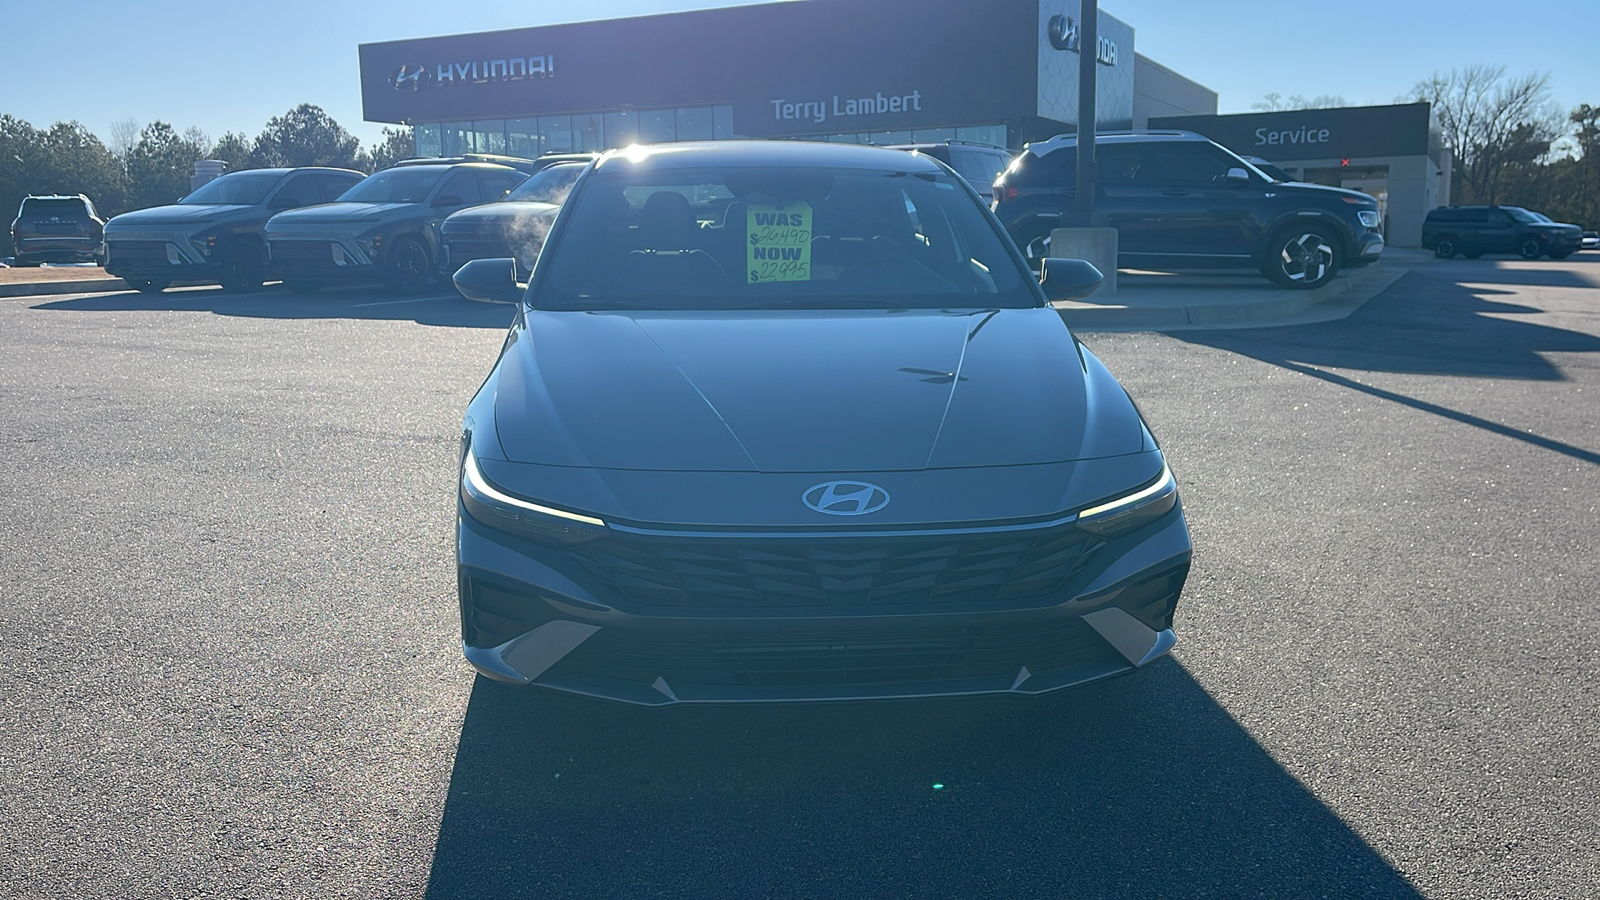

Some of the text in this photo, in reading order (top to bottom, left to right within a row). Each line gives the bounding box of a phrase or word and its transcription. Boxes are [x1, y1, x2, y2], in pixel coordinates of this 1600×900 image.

[437, 54, 554, 86] HYUNDAI
[771, 90, 922, 122] Terry Lambert
[1254, 125, 1330, 146] Service
[755, 213, 803, 226] WAS
[753, 247, 802, 261] NOW
